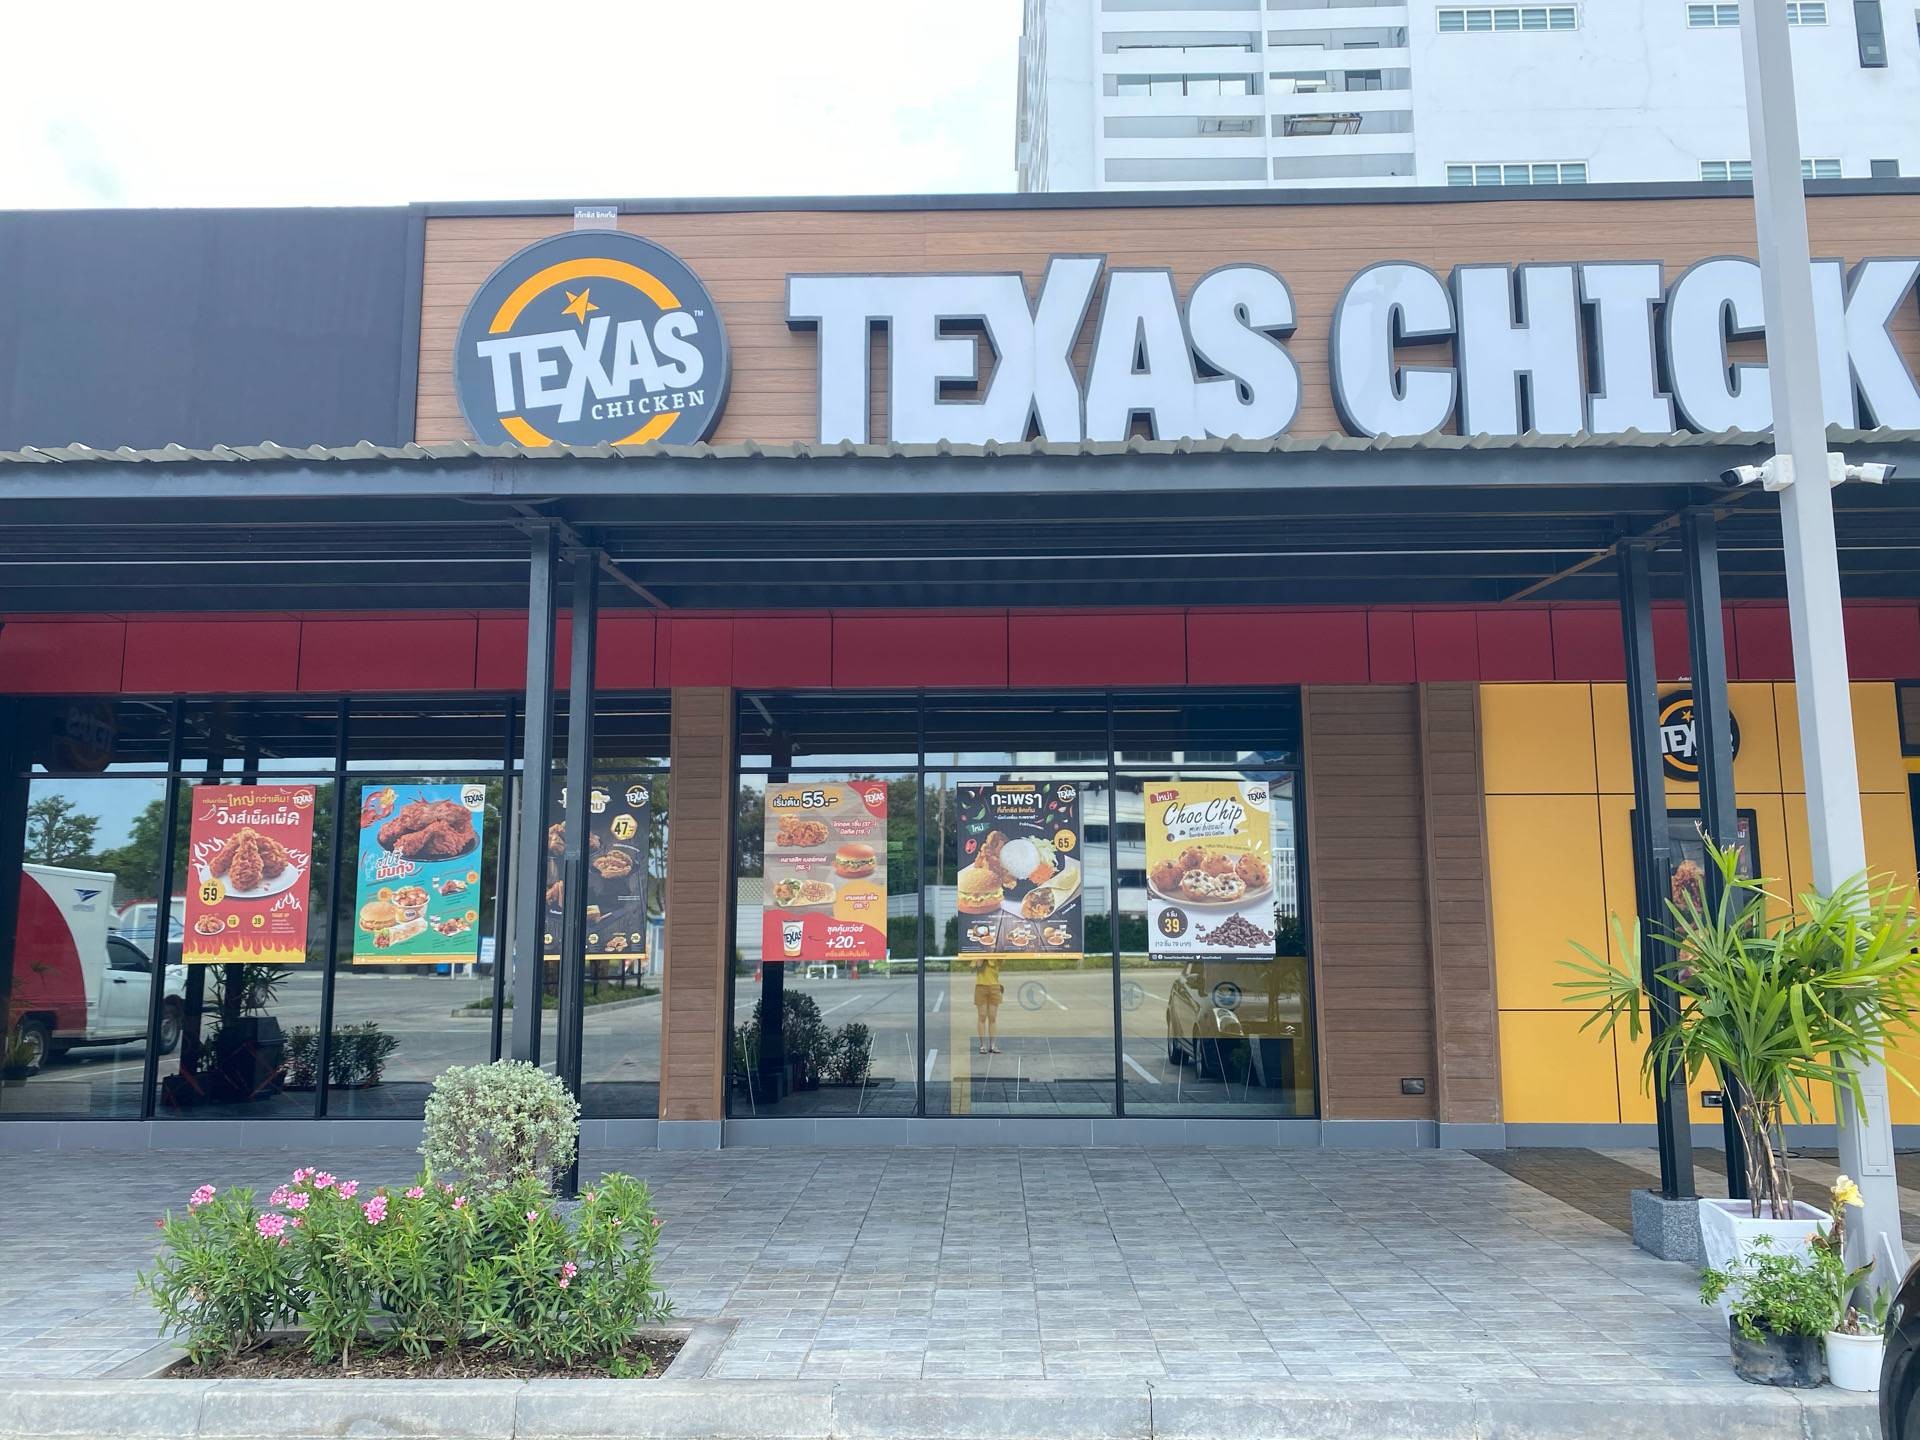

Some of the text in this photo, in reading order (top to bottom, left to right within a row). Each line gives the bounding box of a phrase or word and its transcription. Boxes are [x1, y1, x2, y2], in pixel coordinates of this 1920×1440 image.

[785, 253, 1301, 444] TEXAS
[476, 311, 704, 424] TEXAS
[591, 389, 705, 421] CHICKEN
[227, 791, 255, 806] ใหญ่
[292, 794, 313, 805] TEXAS
[464, 794, 484, 804] TEXAS
[625, 791, 649, 803] TEXAS
[773, 790, 838, 808] เริ่มต้น 55.-
[864, 793, 885, 803] TEXAS
[990, 793, 1043, 809] กะเพรา
[1056, 790, 1076, 799] TEXAS
[1248, 792, 1266, 802] TEXAS
[216, 806, 300, 825] วิงส์เผ็ดเผ็ด
[1162, 798, 1243, 830] Choc Chip
[972, 824, 984, 832] ใหม่
[1058, 838, 1070, 848] 65
[826, 936, 866, 949] +20.-
